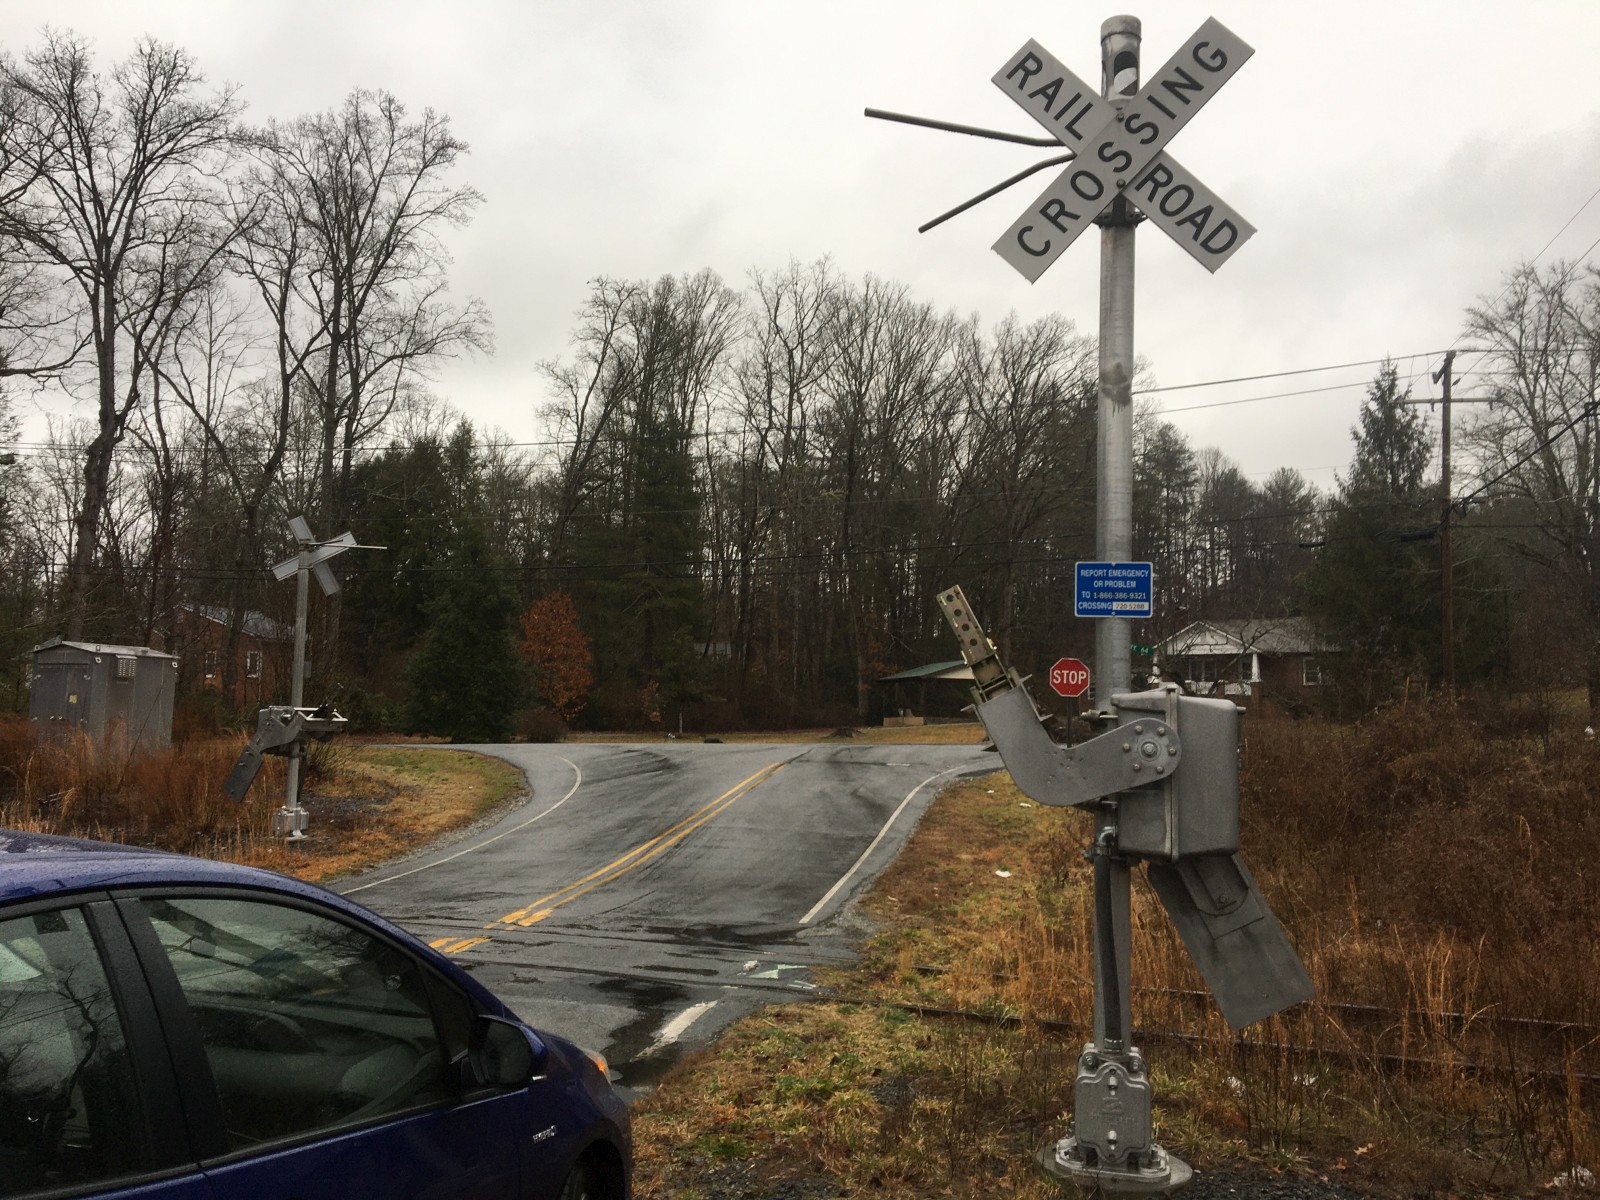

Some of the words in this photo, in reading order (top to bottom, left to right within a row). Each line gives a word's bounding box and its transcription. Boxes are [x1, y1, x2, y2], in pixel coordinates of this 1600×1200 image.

[1006, 51, 1094, 141] RAIL
[1016, 41, 1228, 257] CROSSING
[1134, 162, 1238, 255] ROAD
[1080, 569, 1107, 577] REPORT
[1108, 569, 1149, 577] EMERGENCY
[1093, 580, 1104, 588] OR
[1104, 580, 1137, 588] PROBLEM
[1081, 590, 1091, 598] TO
[1078, 601, 1111, 610] CROSSING
[1053, 670, 1087, 685] STOP
